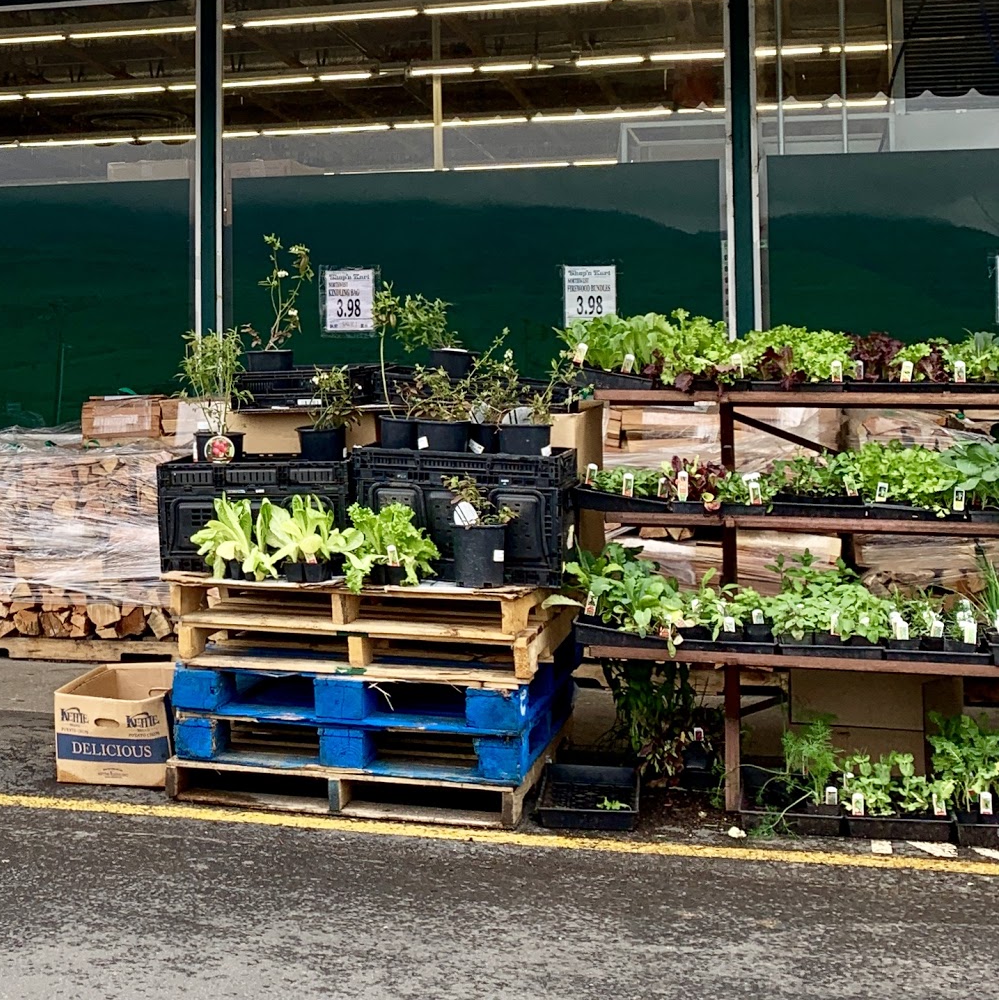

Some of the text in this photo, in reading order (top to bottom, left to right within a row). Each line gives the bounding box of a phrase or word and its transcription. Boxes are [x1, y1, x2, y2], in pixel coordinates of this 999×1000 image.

[337, 299, 361, 317] 3.98
[576, 295, 603, 315] 3.98
[71, 741, 152, 758] DELICIOUS
